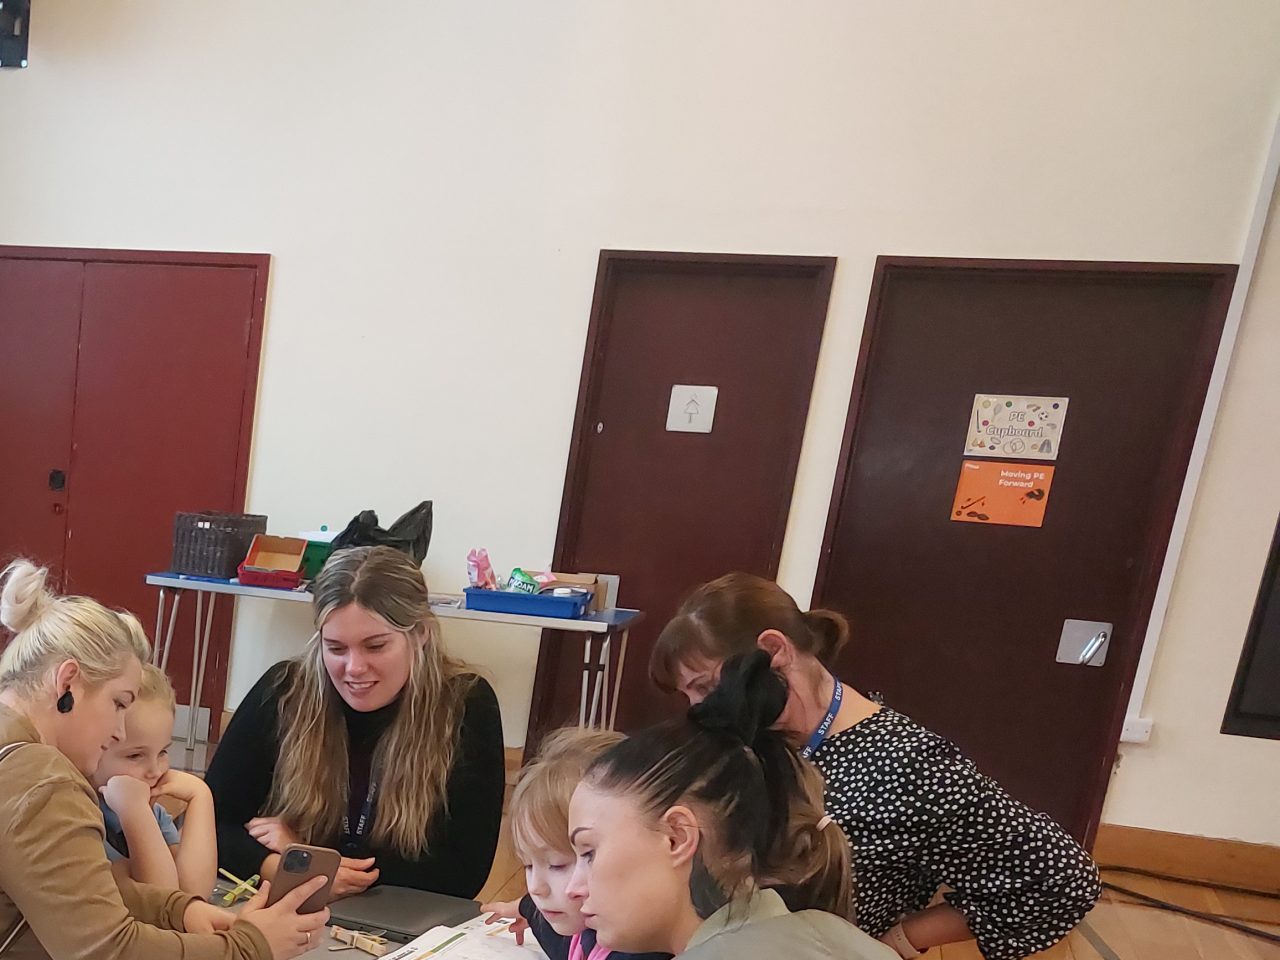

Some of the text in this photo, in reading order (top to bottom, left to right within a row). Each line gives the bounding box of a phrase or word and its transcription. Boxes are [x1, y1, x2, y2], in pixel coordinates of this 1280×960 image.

[1009, 411, 1025, 422] PE
[986, 424, 1043, 438] Cupboard
[1000, 470, 1045, 480] Moving PE
[999, 479, 1034, 488] Forward
[817, 712, 834, 735] STAFF
[356, 814, 367, 835] STAFF
